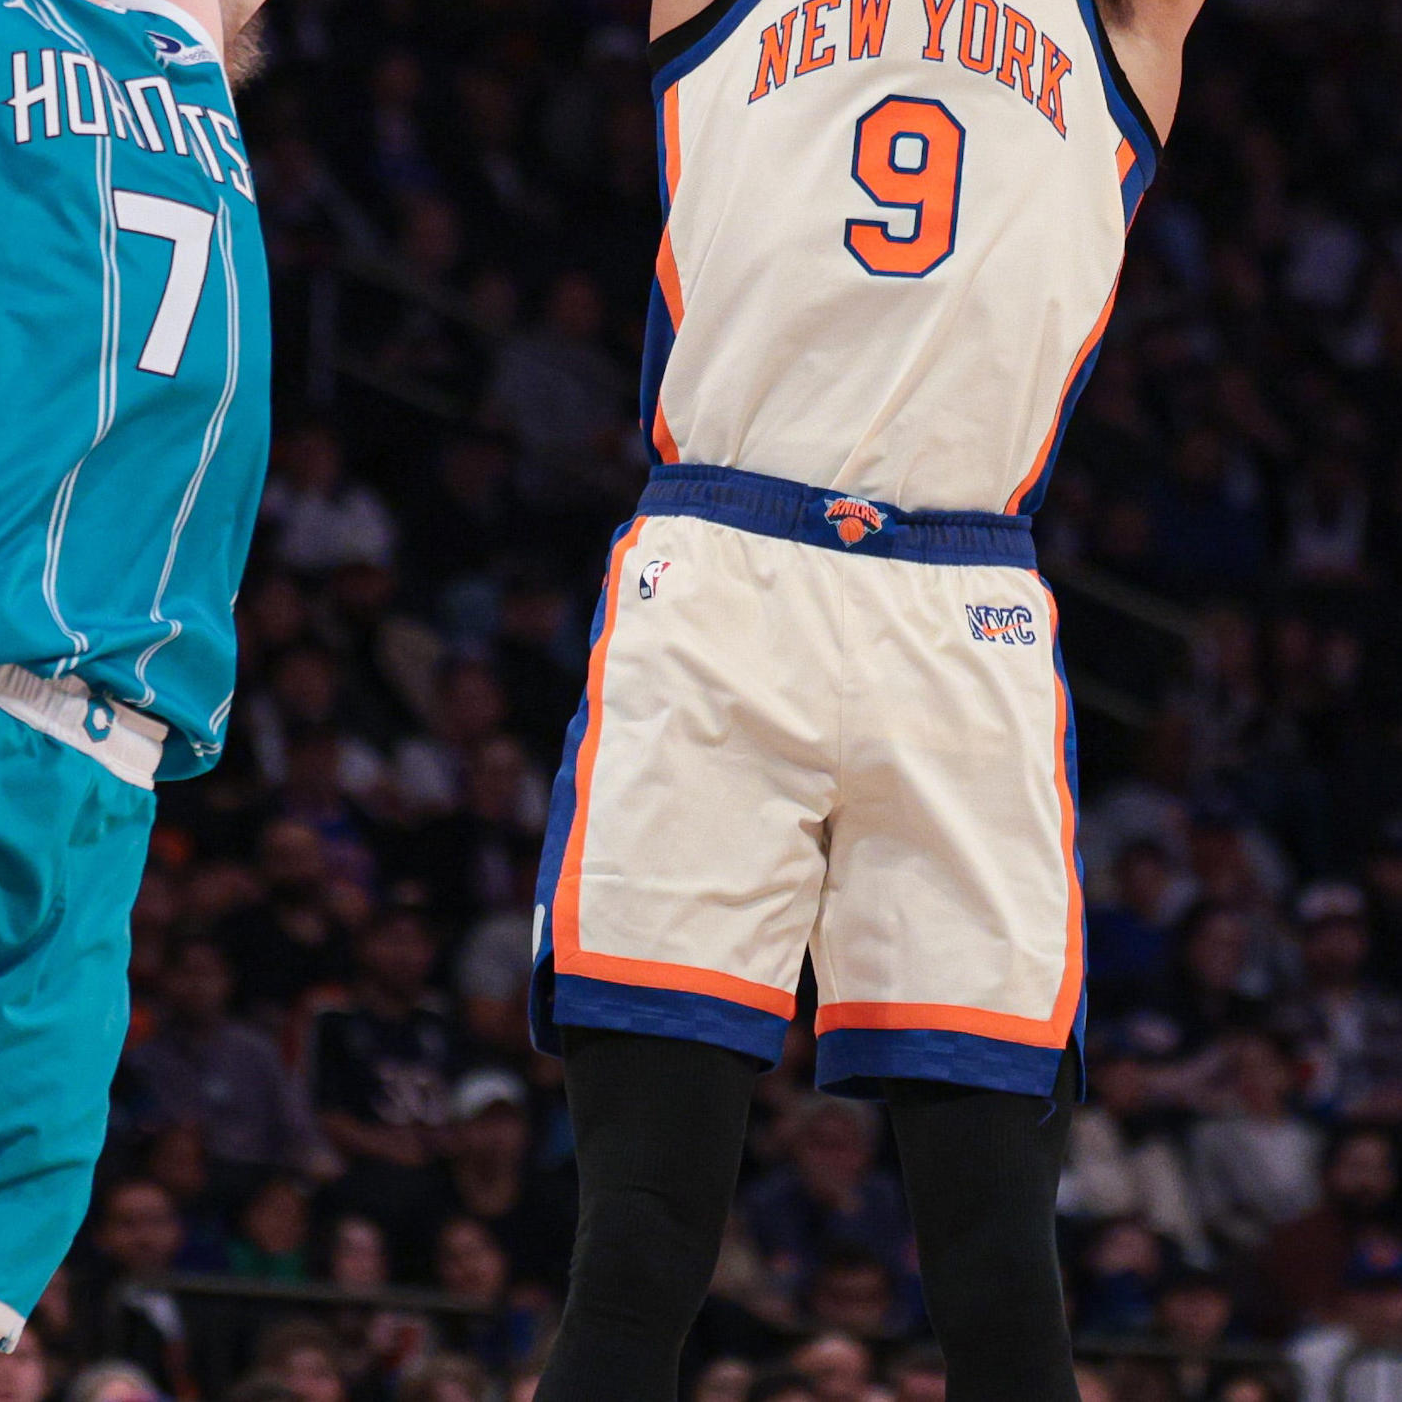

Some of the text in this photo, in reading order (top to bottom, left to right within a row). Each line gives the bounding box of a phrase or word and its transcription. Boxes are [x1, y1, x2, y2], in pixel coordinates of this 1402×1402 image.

[2, 48, 257, 204] HORNTS
[844, 94, 966, 279] 9
[111, 186, 217, 378] 7
[826, 498, 882, 530] KNICKS
[965, 603, 1036, 645] NYC
